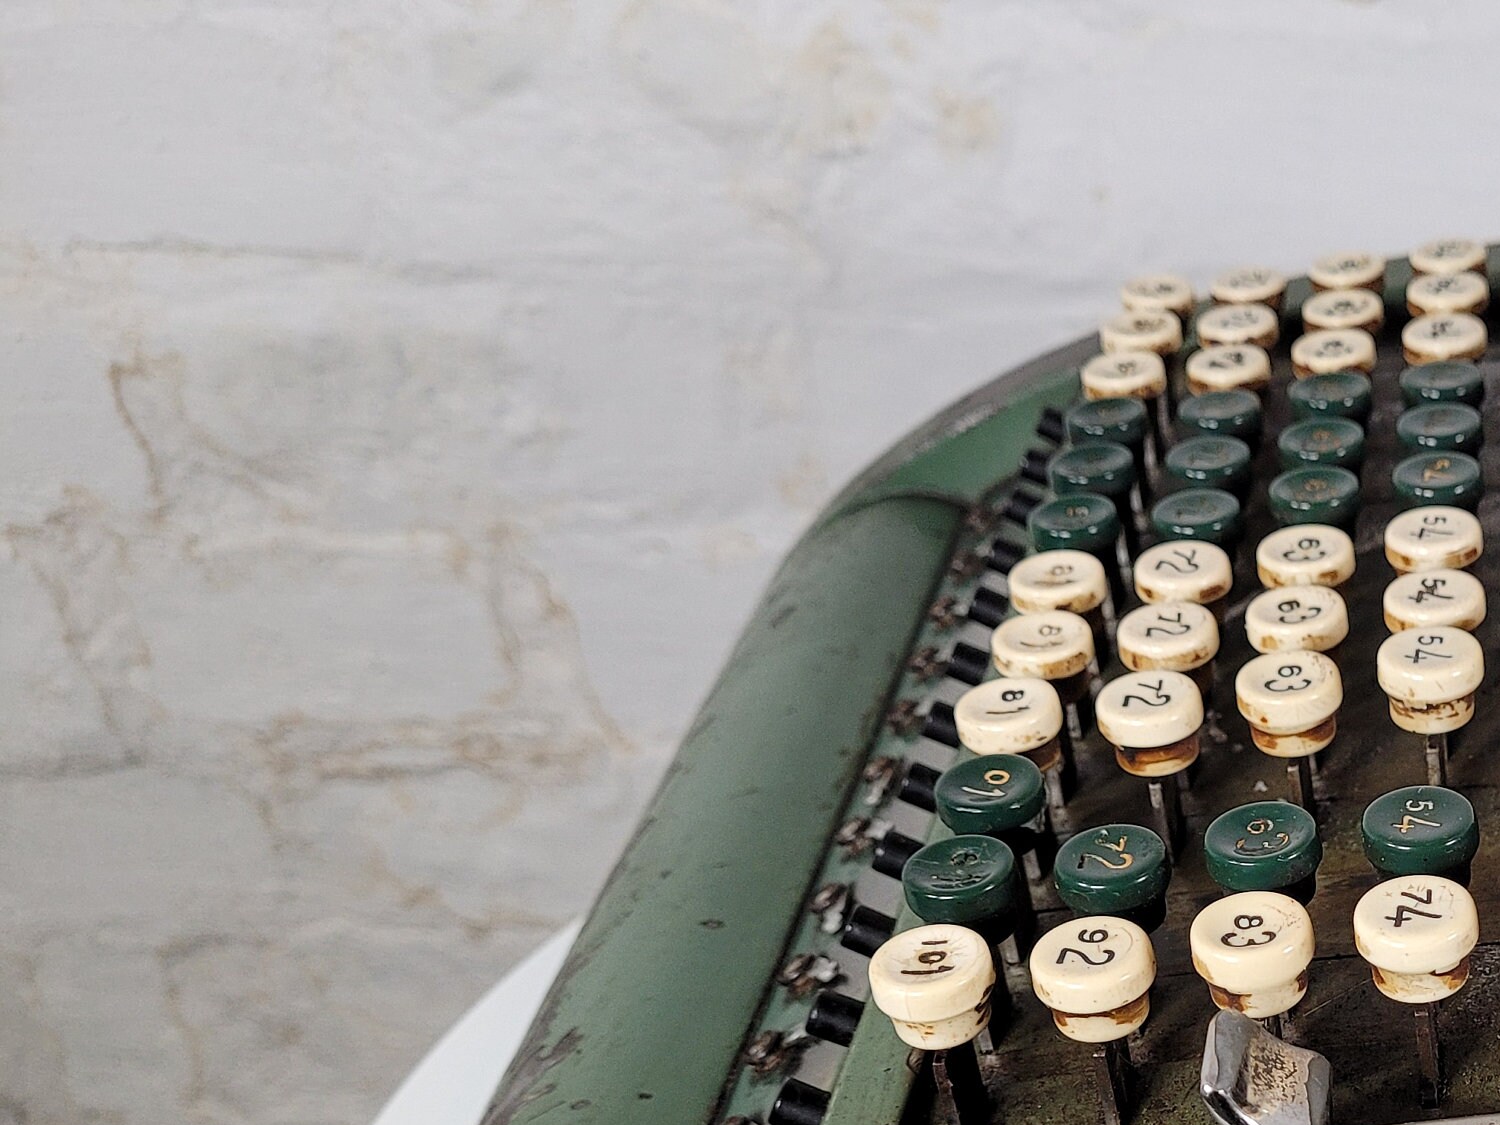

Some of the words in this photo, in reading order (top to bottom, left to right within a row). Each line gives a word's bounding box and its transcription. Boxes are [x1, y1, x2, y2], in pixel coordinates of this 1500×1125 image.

[1404, 635, 1453, 664] 54
[1121, 680, 1172, 708] 72
[1264, 664, 1312, 692] 63
[1390, 799, 1441, 833] 54
[1384, 888, 1443, 928] 74
[1055, 929, 1116, 966] 92
[1220, 914, 1277, 948] 83
